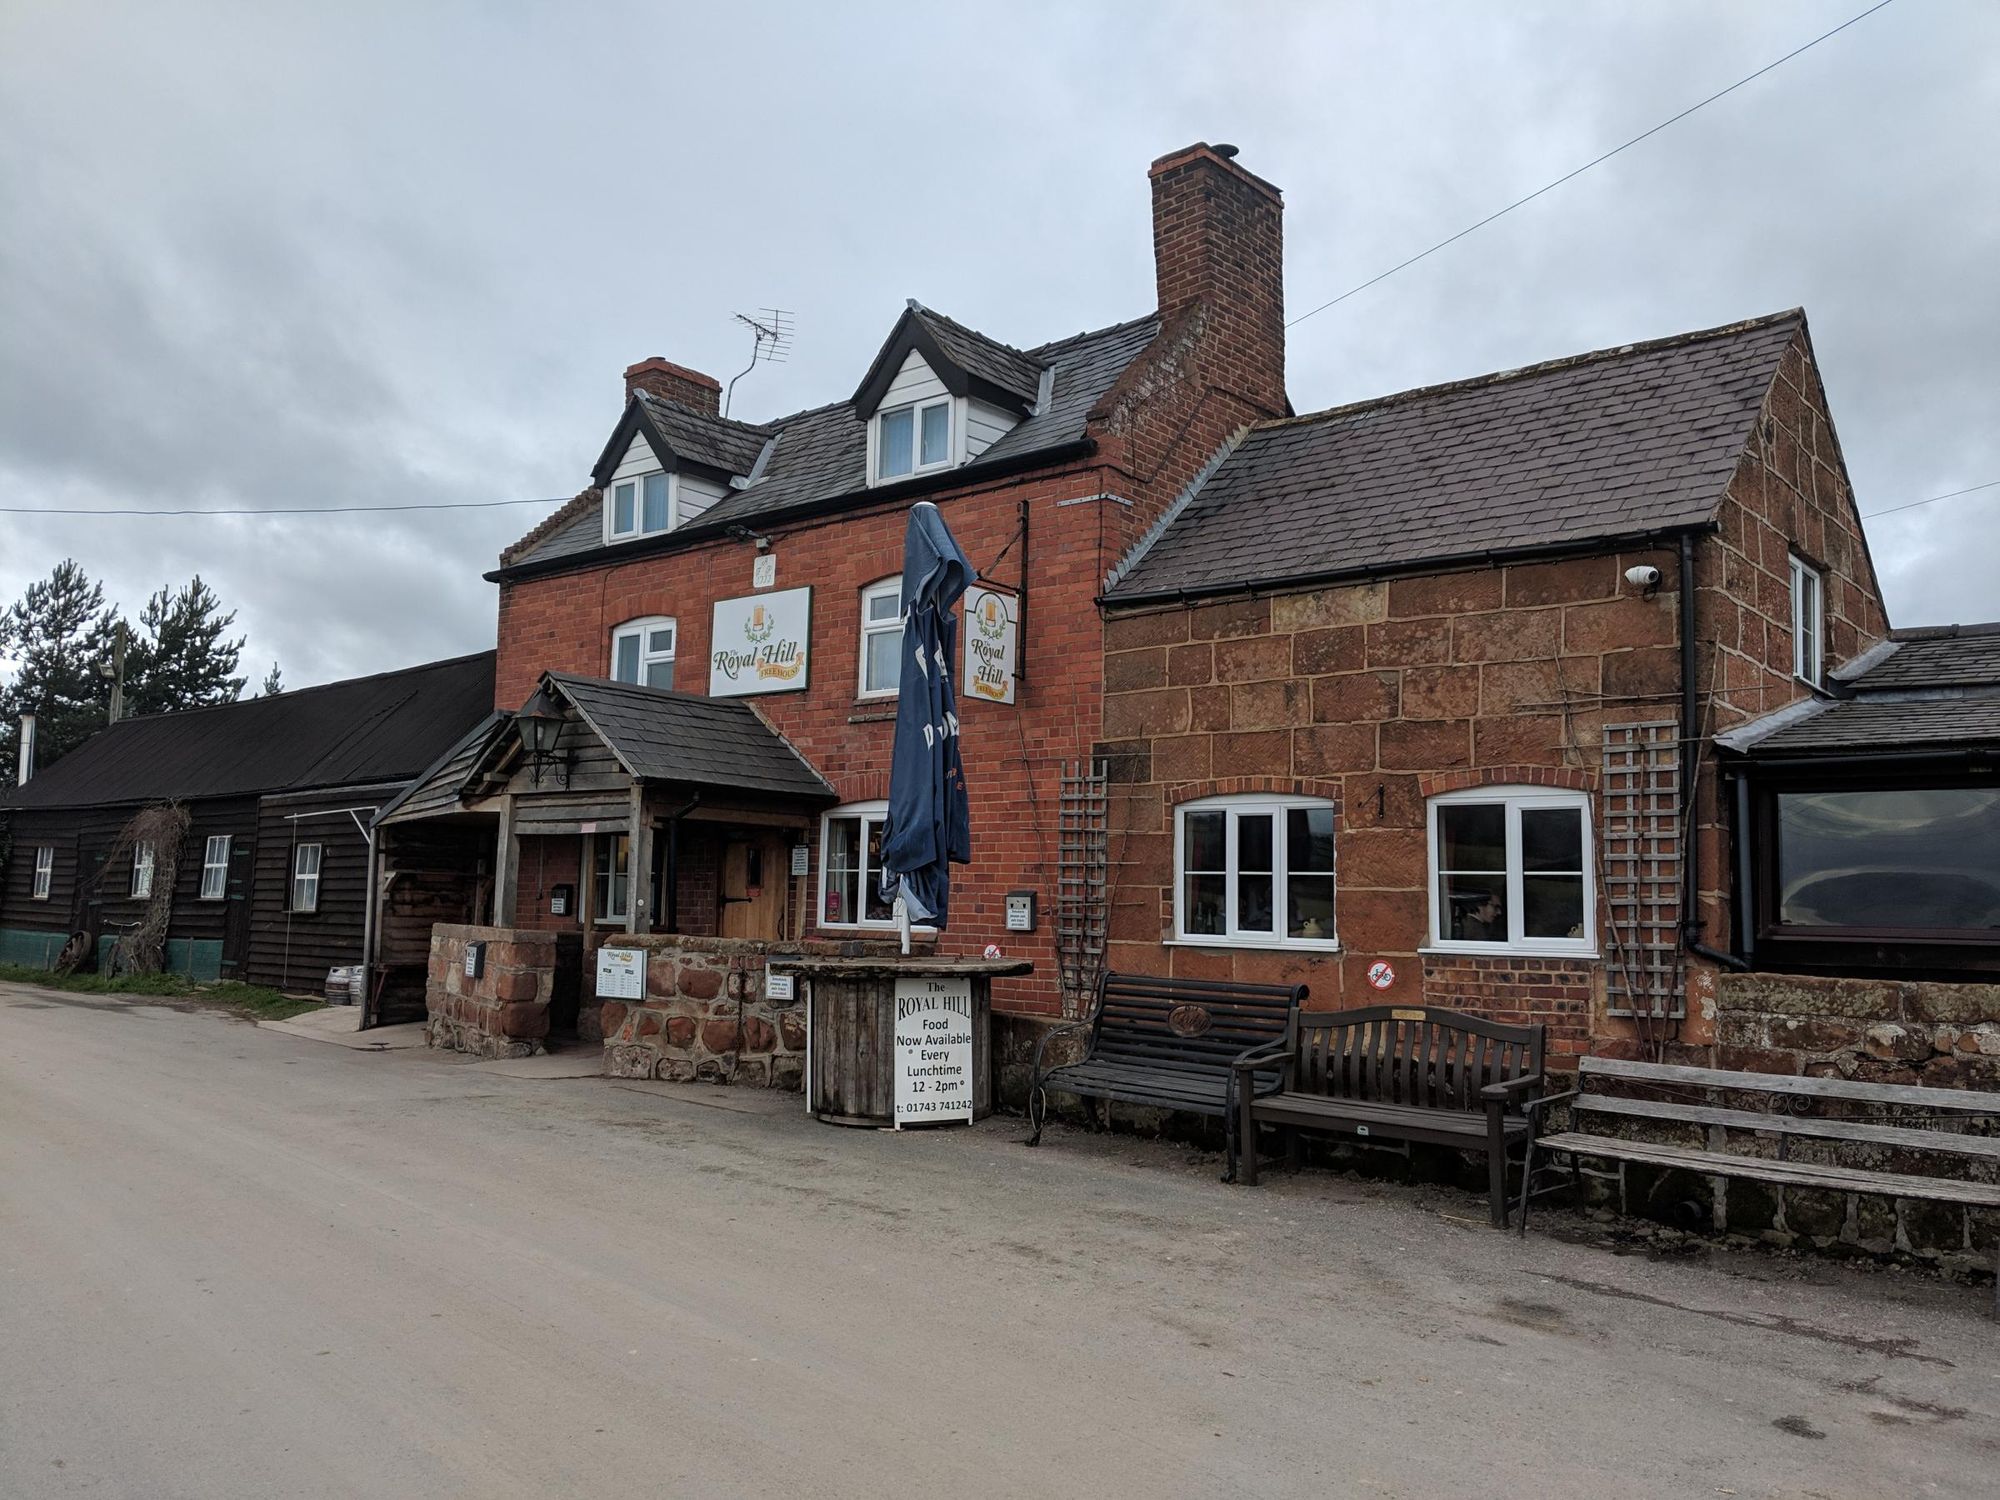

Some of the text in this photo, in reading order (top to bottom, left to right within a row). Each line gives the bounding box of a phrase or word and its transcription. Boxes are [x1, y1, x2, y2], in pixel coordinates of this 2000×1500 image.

[971, 638, 1005, 666] Royal
[713, 639, 798, 680] Royal Hill
[978, 664, 1004, 685] Hill
[927, 982, 945, 992] The
[898, 996, 970, 1021] ROYAL HILL
[922, 1018, 949, 1030] Food
[897, 1034, 972, 1046] Now Available
[921, 1049, 950, 1062] Every
[907, 1065, 962, 1077] Lunchtime
[912, 1081, 925, 1093] 12
[935, 1080, 958, 1094] 2pm
[896, 1100, 972, 1113] t: 01743 741242
